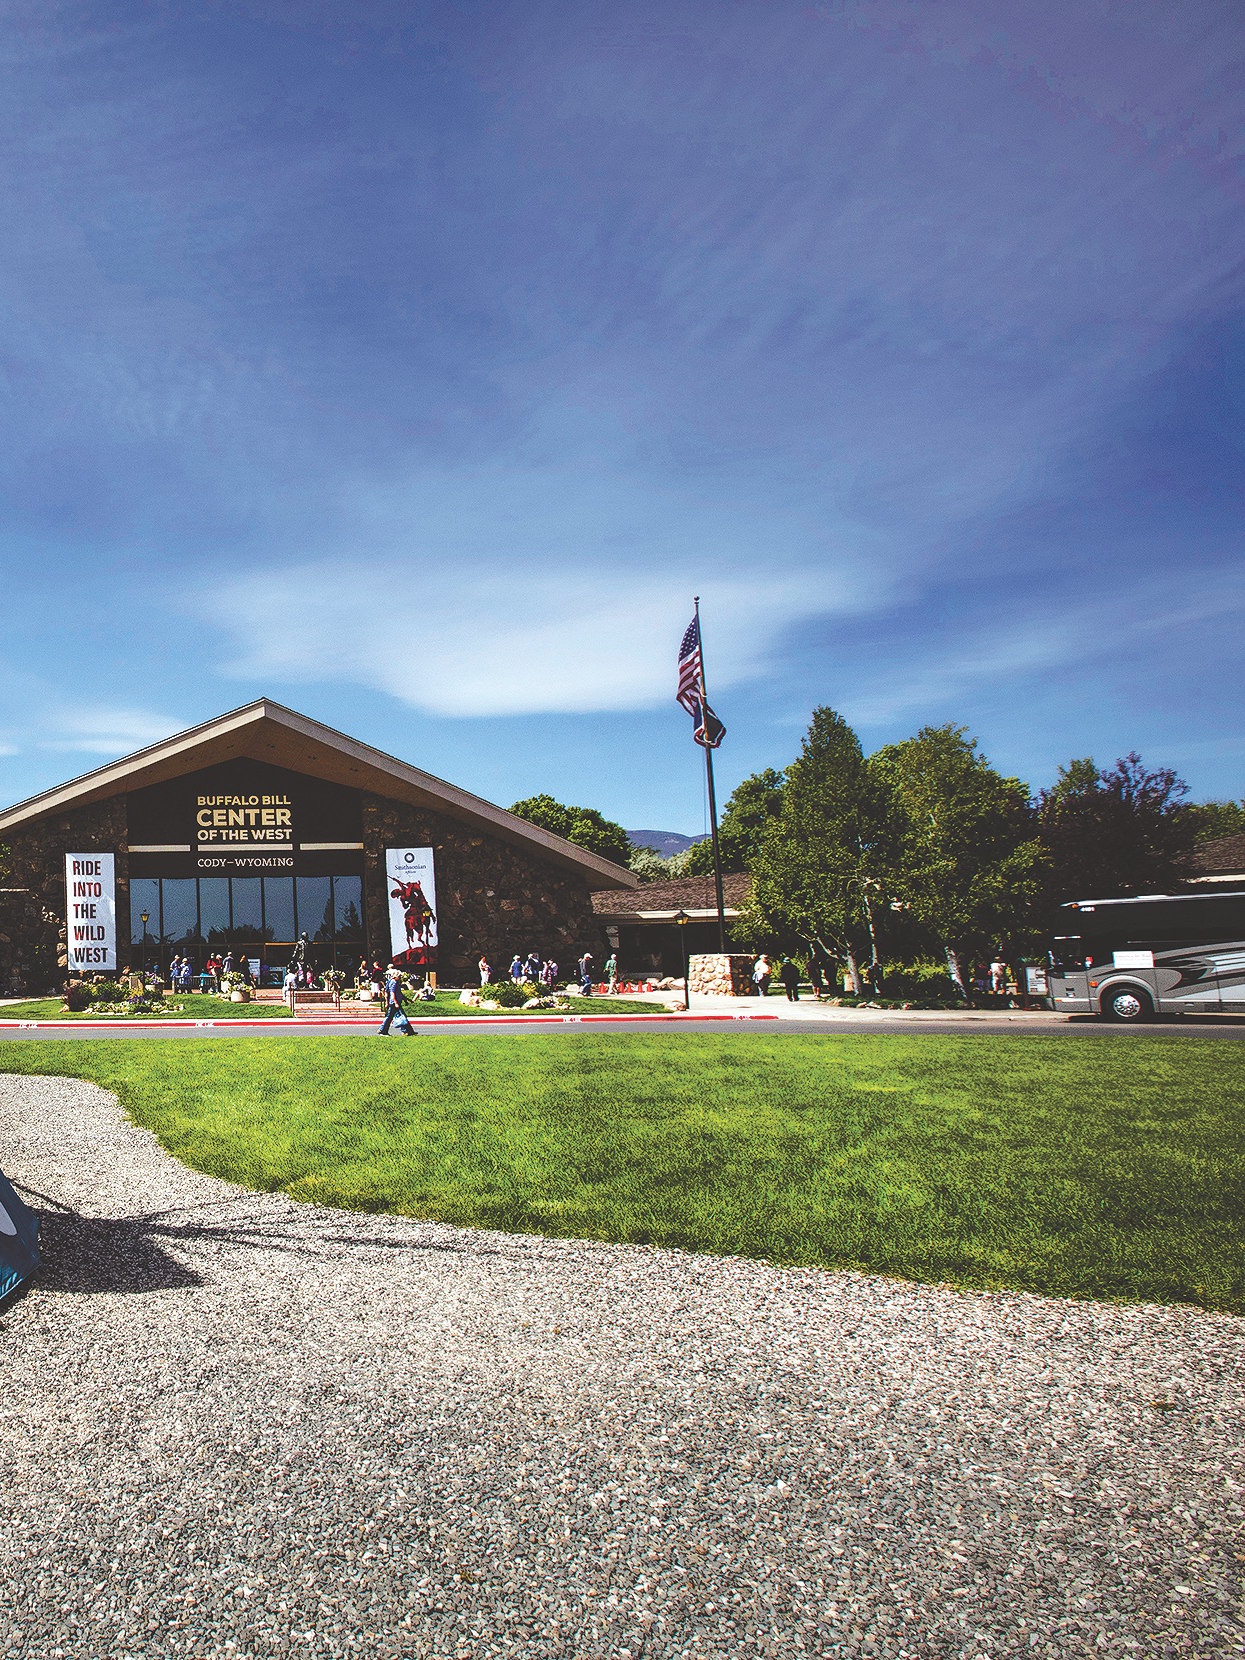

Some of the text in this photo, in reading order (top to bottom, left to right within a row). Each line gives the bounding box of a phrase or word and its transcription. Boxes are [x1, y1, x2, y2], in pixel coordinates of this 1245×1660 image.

[197, 795, 291, 806] BUFFALO BILL
[196, 808, 292, 827] CENTER
[197, 829, 292, 841] OF THE WEST
[73, 861, 101, 875] RIDE
[73, 882, 102, 897] INTO
[73, 904, 96, 919] THE
[73, 926, 105, 940] WILD
[74, 948, 108, 963] WEST
